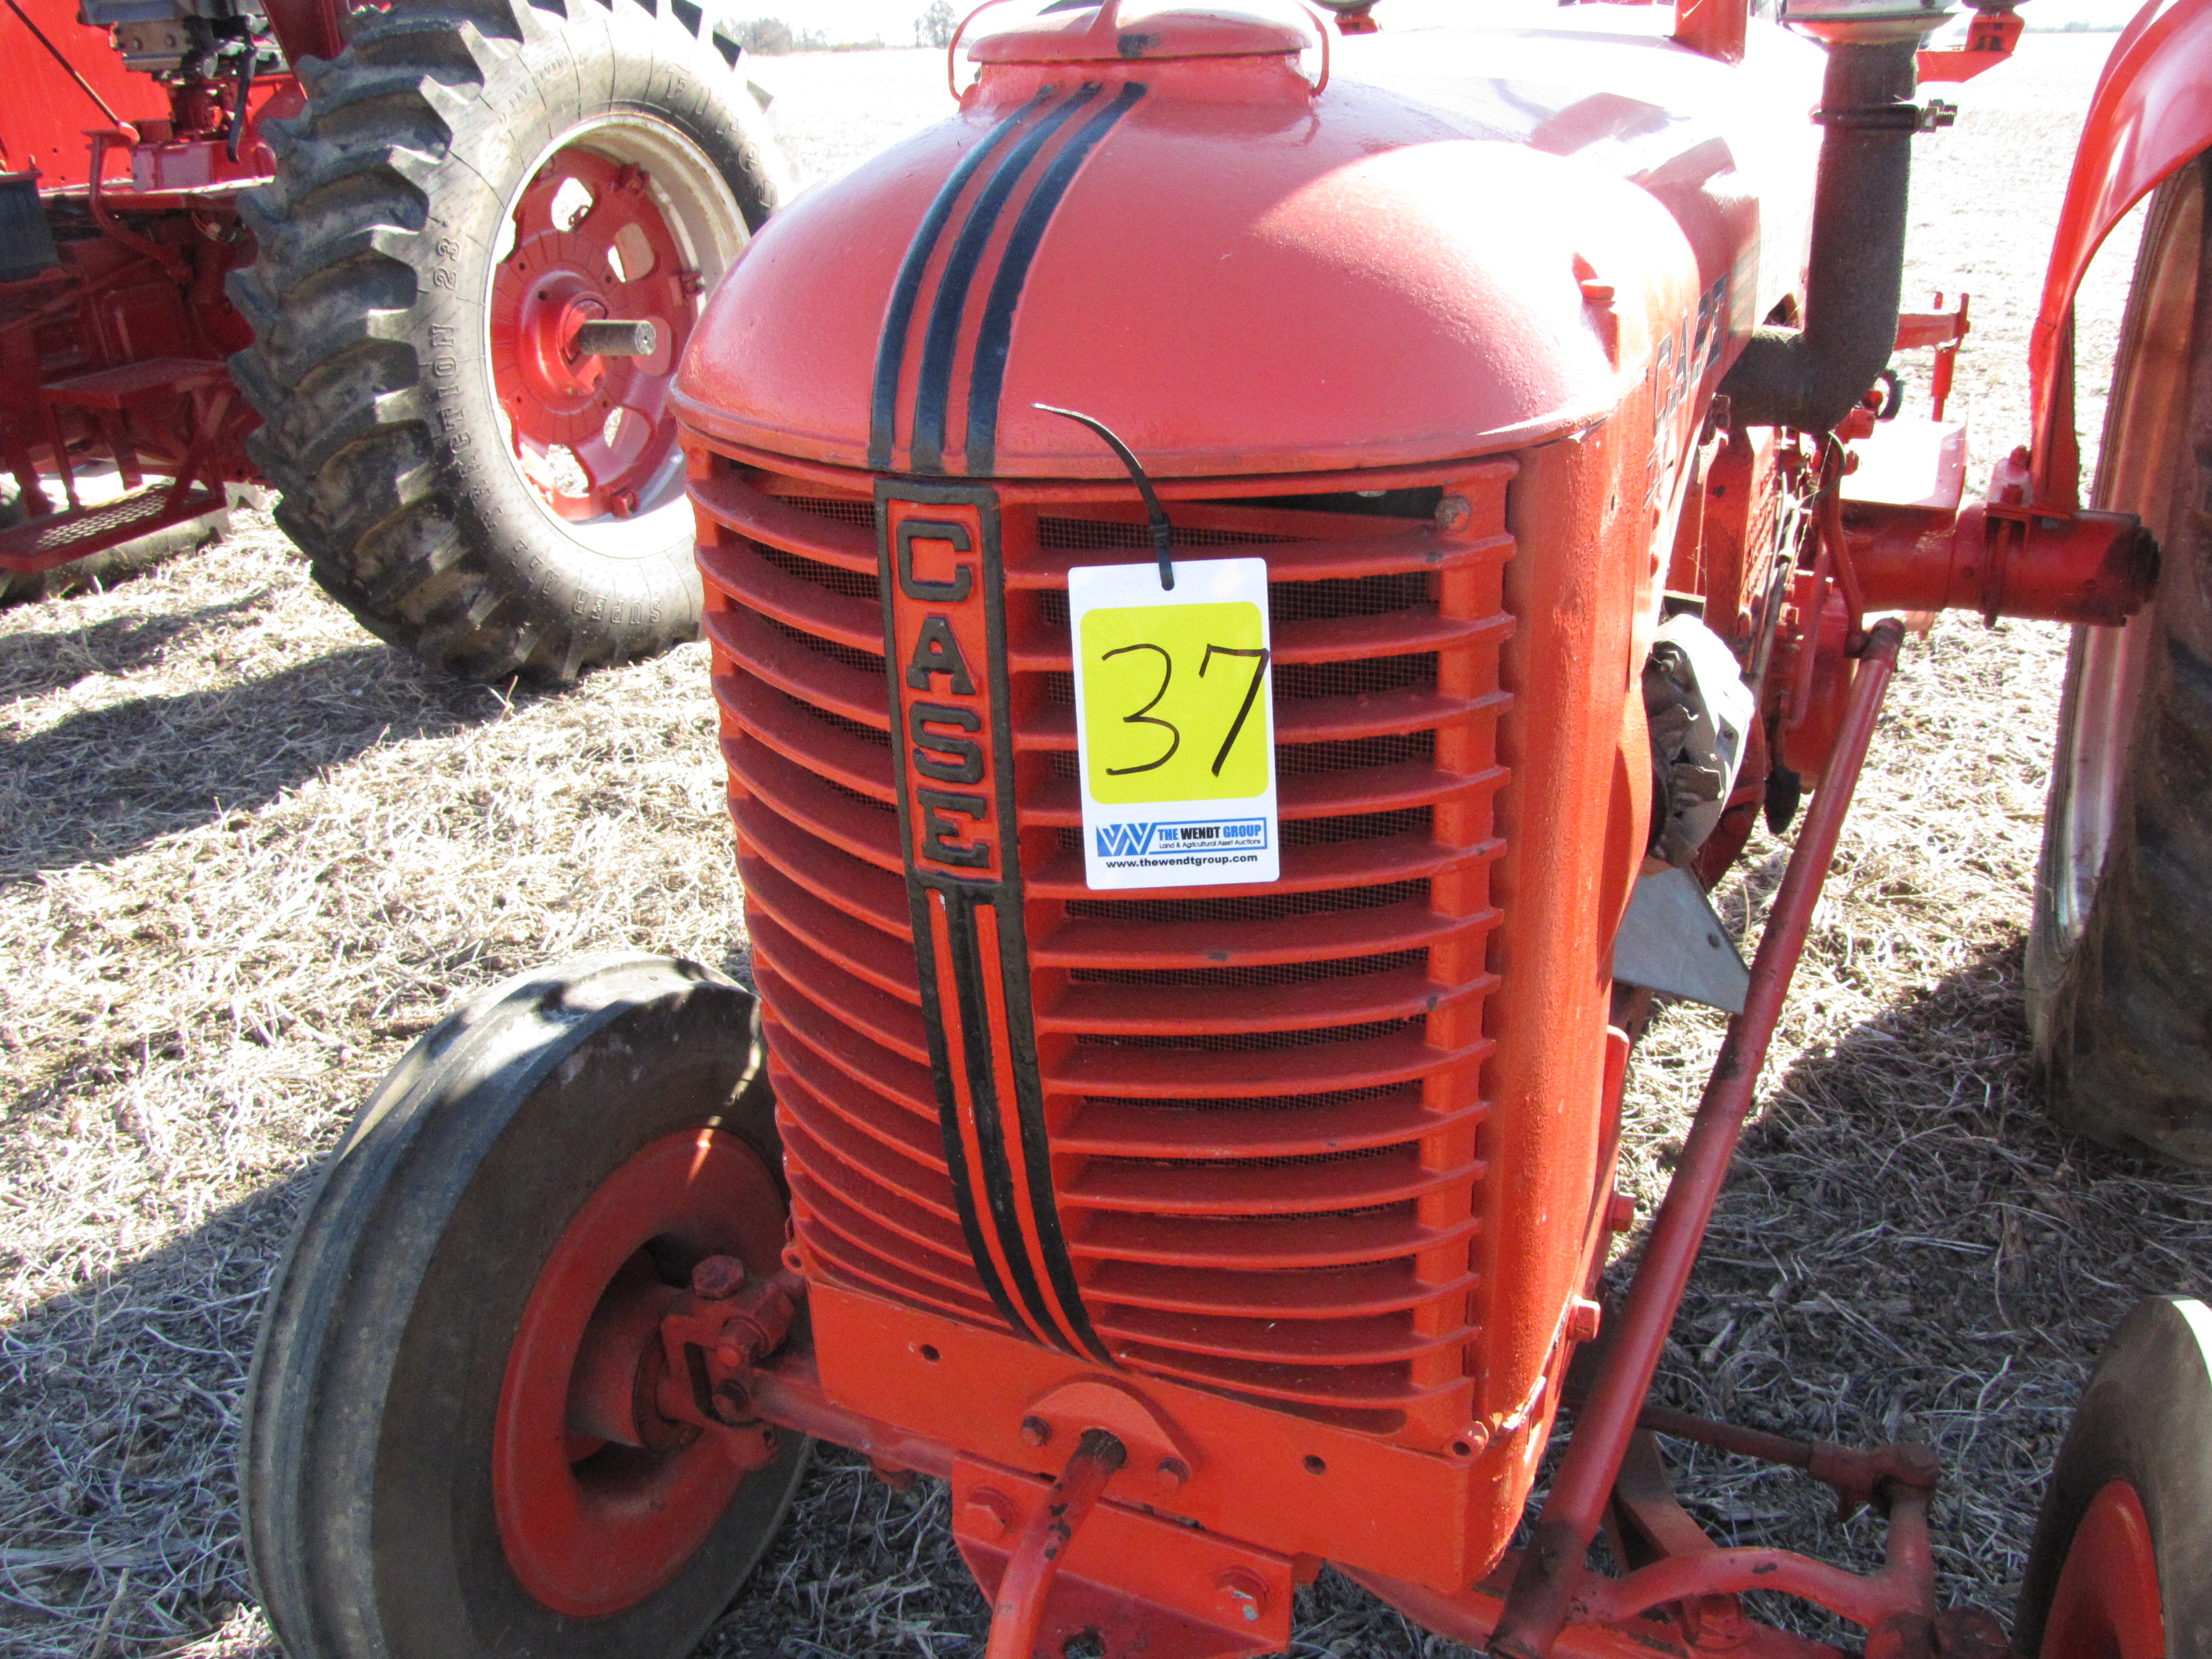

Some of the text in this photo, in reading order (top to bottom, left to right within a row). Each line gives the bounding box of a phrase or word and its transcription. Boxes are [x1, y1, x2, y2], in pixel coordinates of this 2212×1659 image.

[1654, 272, 1727, 442] CASE
[429, 323, 503, 534] TRACTION
[573, 587, 661, 624] SUPER
[896, 518, 991, 869] CASE
[1101, 642, 1269, 778] 37
[1105, 854, 1258, 869] www.thewendtgroup.com
[1157, 824, 1262, 841] THE WENDT GROUP
[1183, 840, 1216, 850] Agricultural
